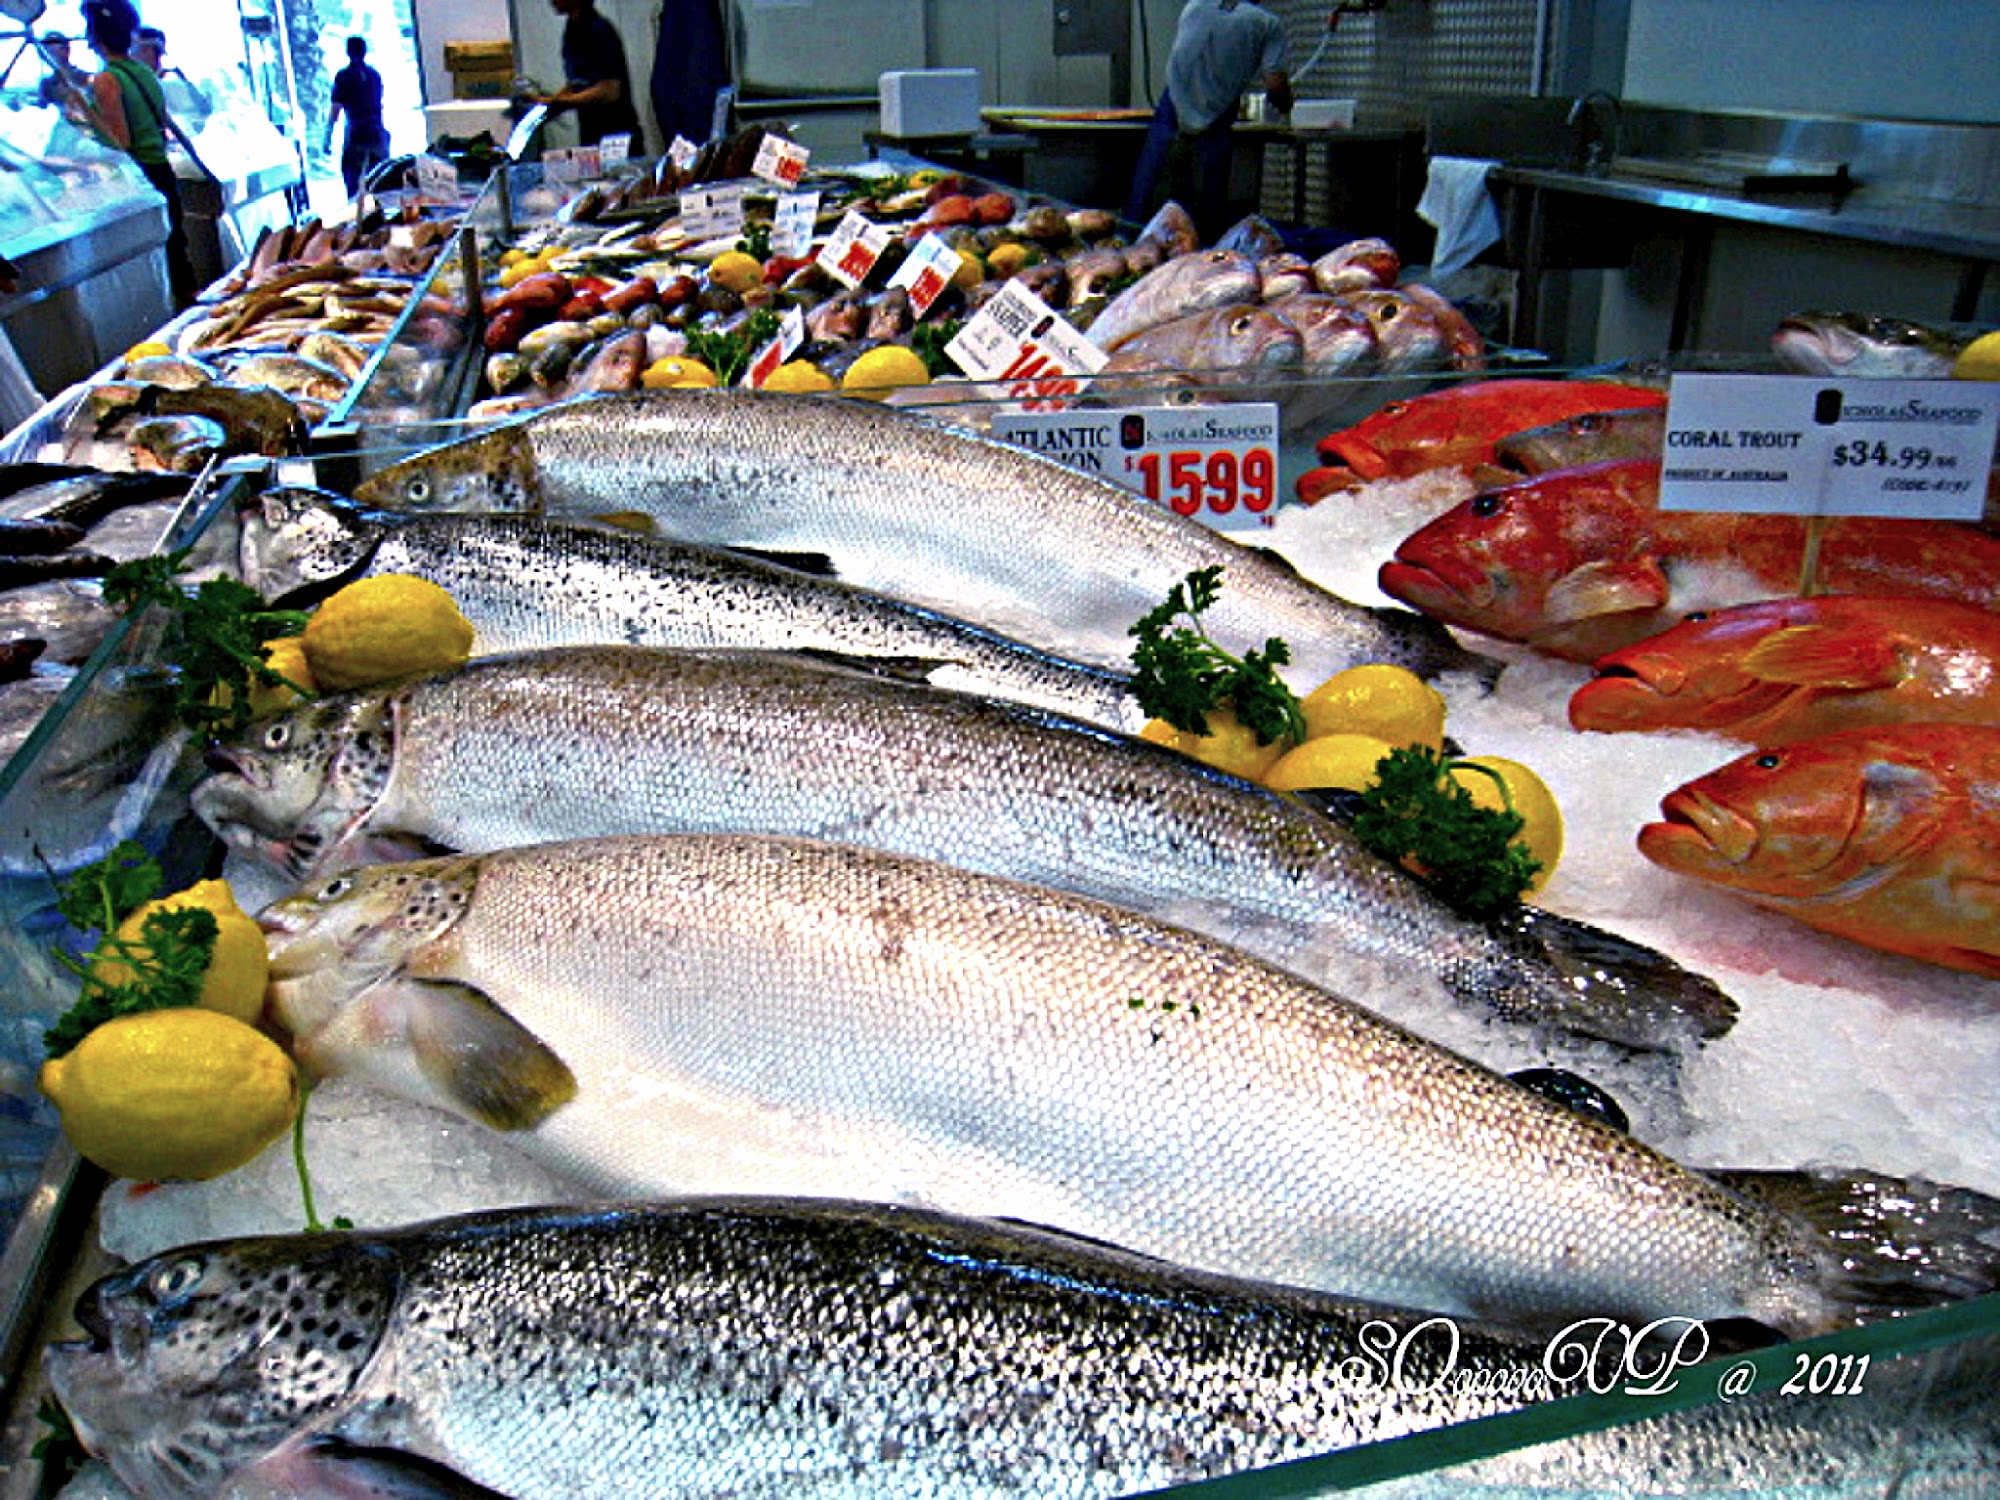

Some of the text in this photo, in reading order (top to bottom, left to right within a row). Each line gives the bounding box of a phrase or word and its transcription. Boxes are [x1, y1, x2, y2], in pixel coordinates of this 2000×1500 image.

[1667, 431, 1803, 448] CORAL TROUT
[1832, 440, 1932, 470] $34.99
